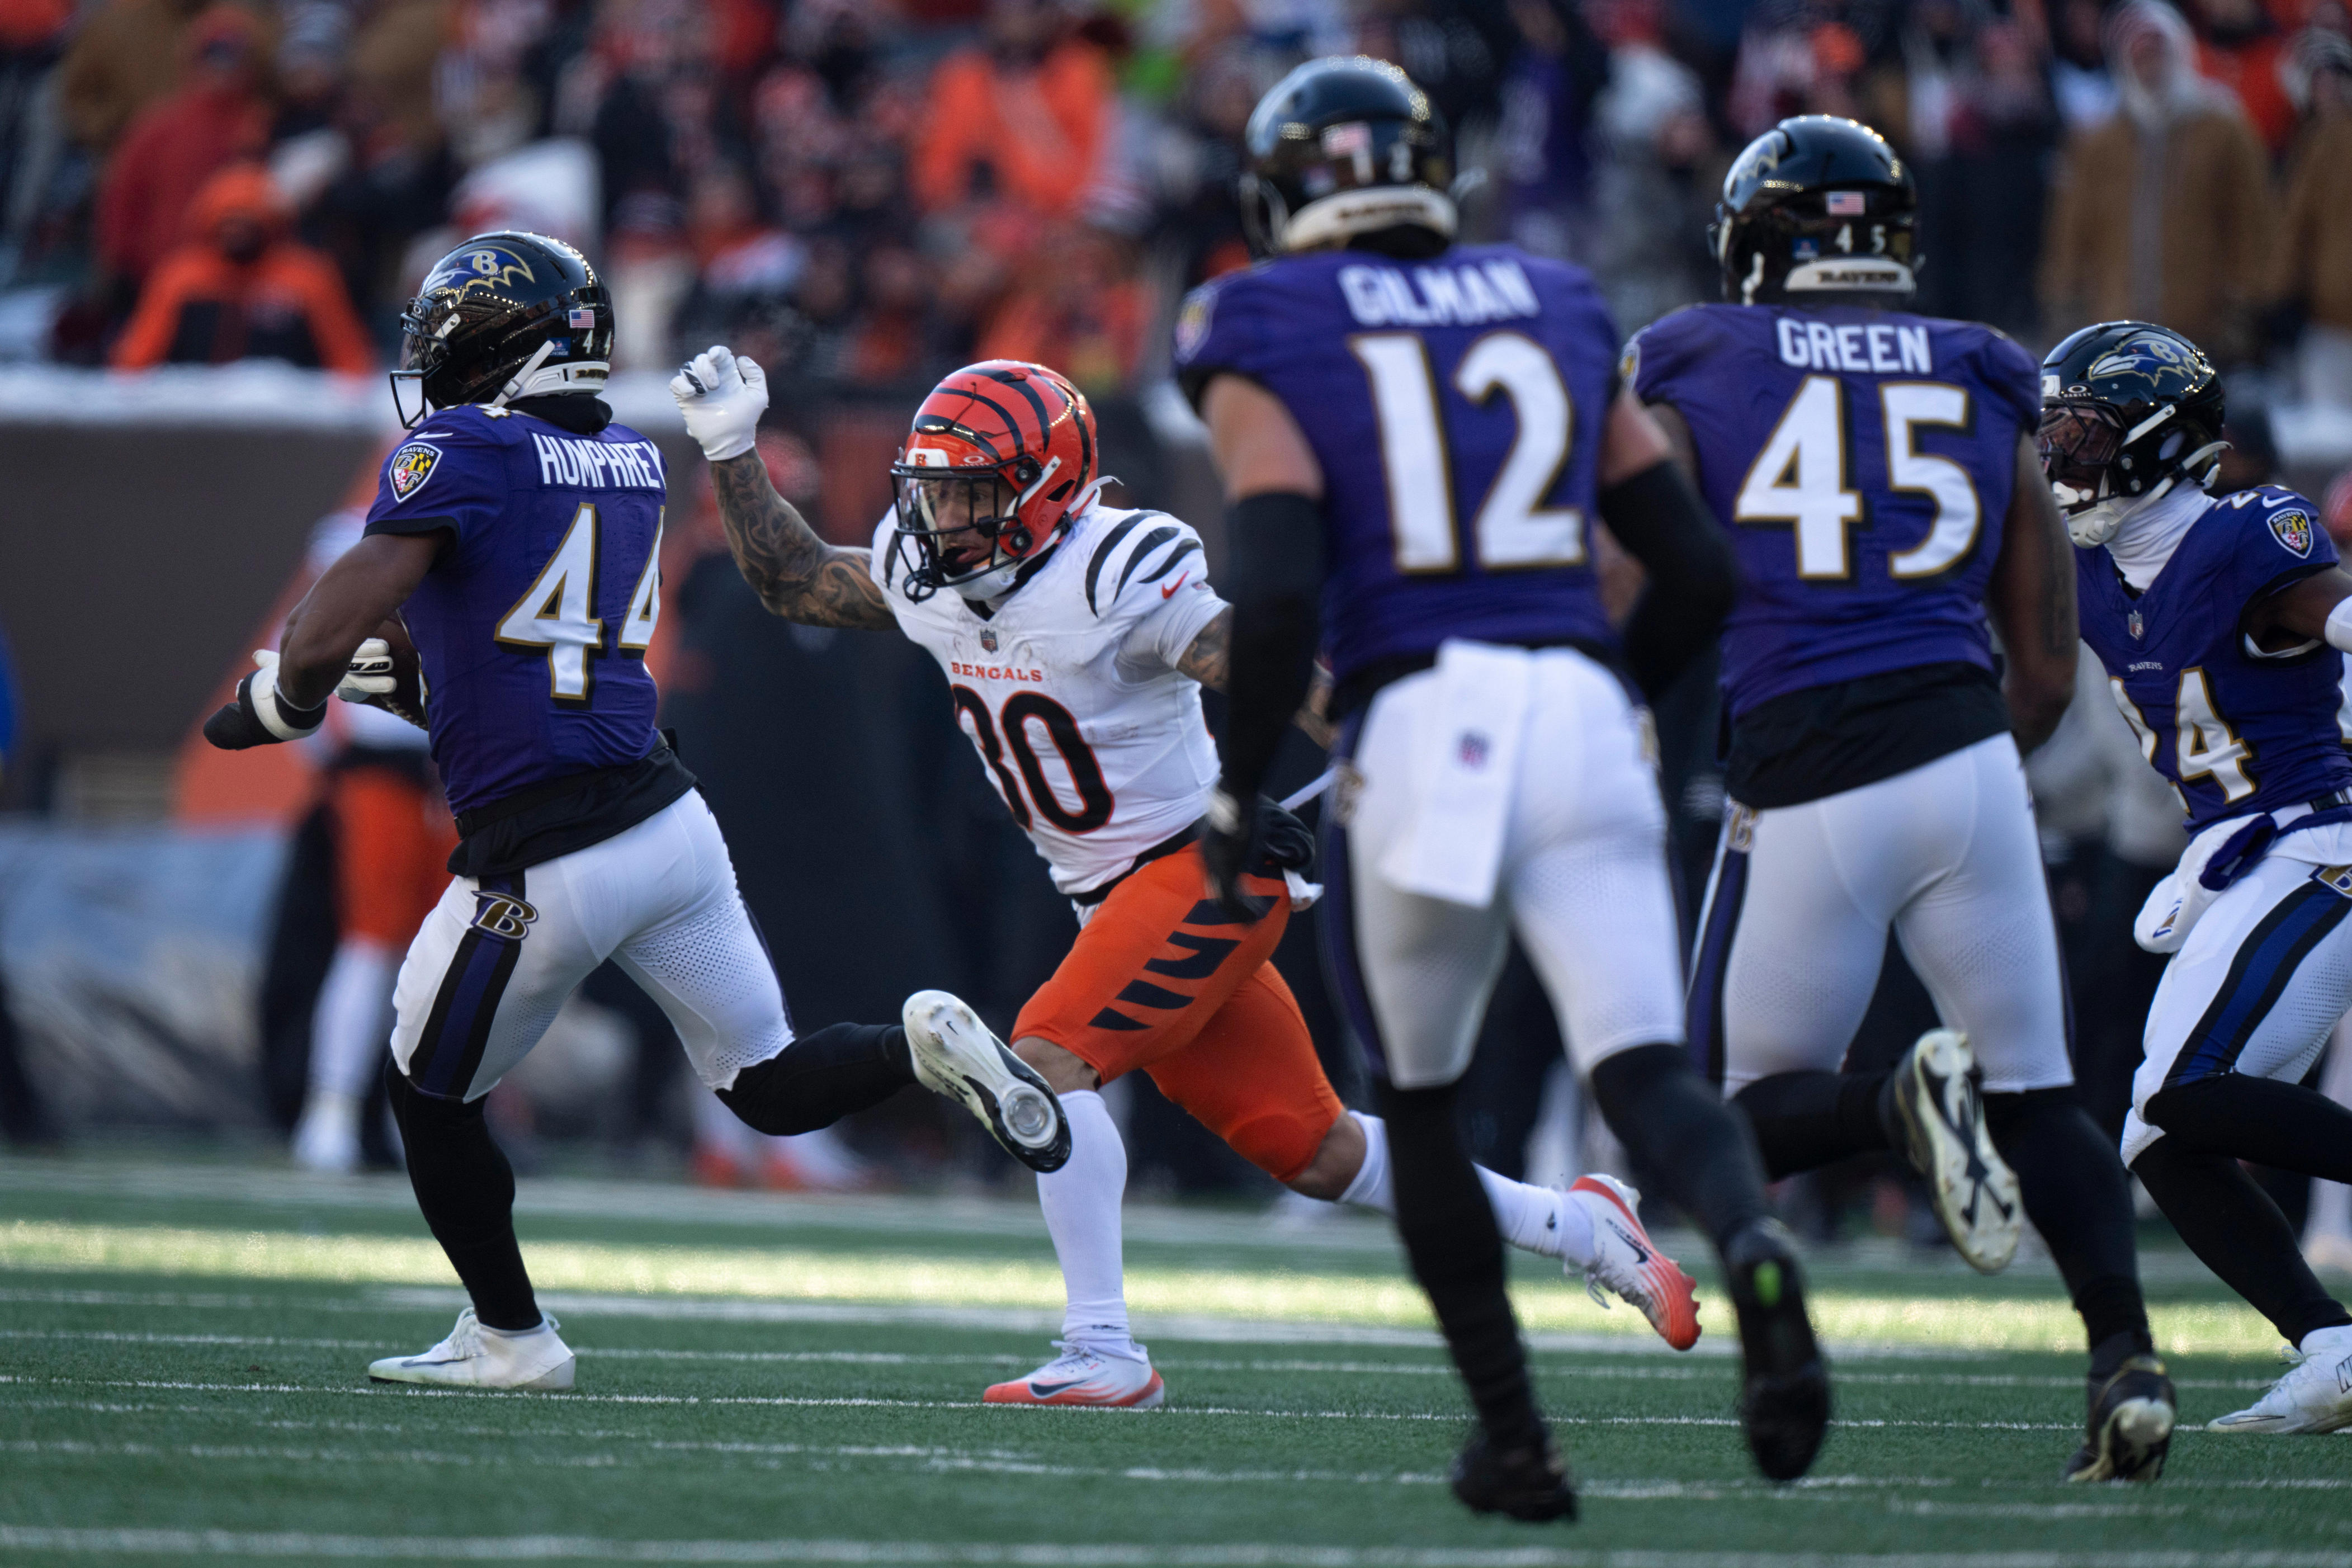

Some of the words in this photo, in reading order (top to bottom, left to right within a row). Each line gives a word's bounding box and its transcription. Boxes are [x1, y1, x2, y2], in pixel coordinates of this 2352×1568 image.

[1337, 262, 1541, 327] GILMAN
[1777, 318, 1931, 374] GREEN
[400, 446, 435, 457] RAVENS
[1349, 331, 1588, 576] 12
[1735, 375, 1981, 579] 45
[2272, 511, 2301, 524] RAVENS
[494, 502, 665, 701] 44
[951, 662, 1043, 682] BENGALS
[2128, 662, 2163, 672] RAVENS
